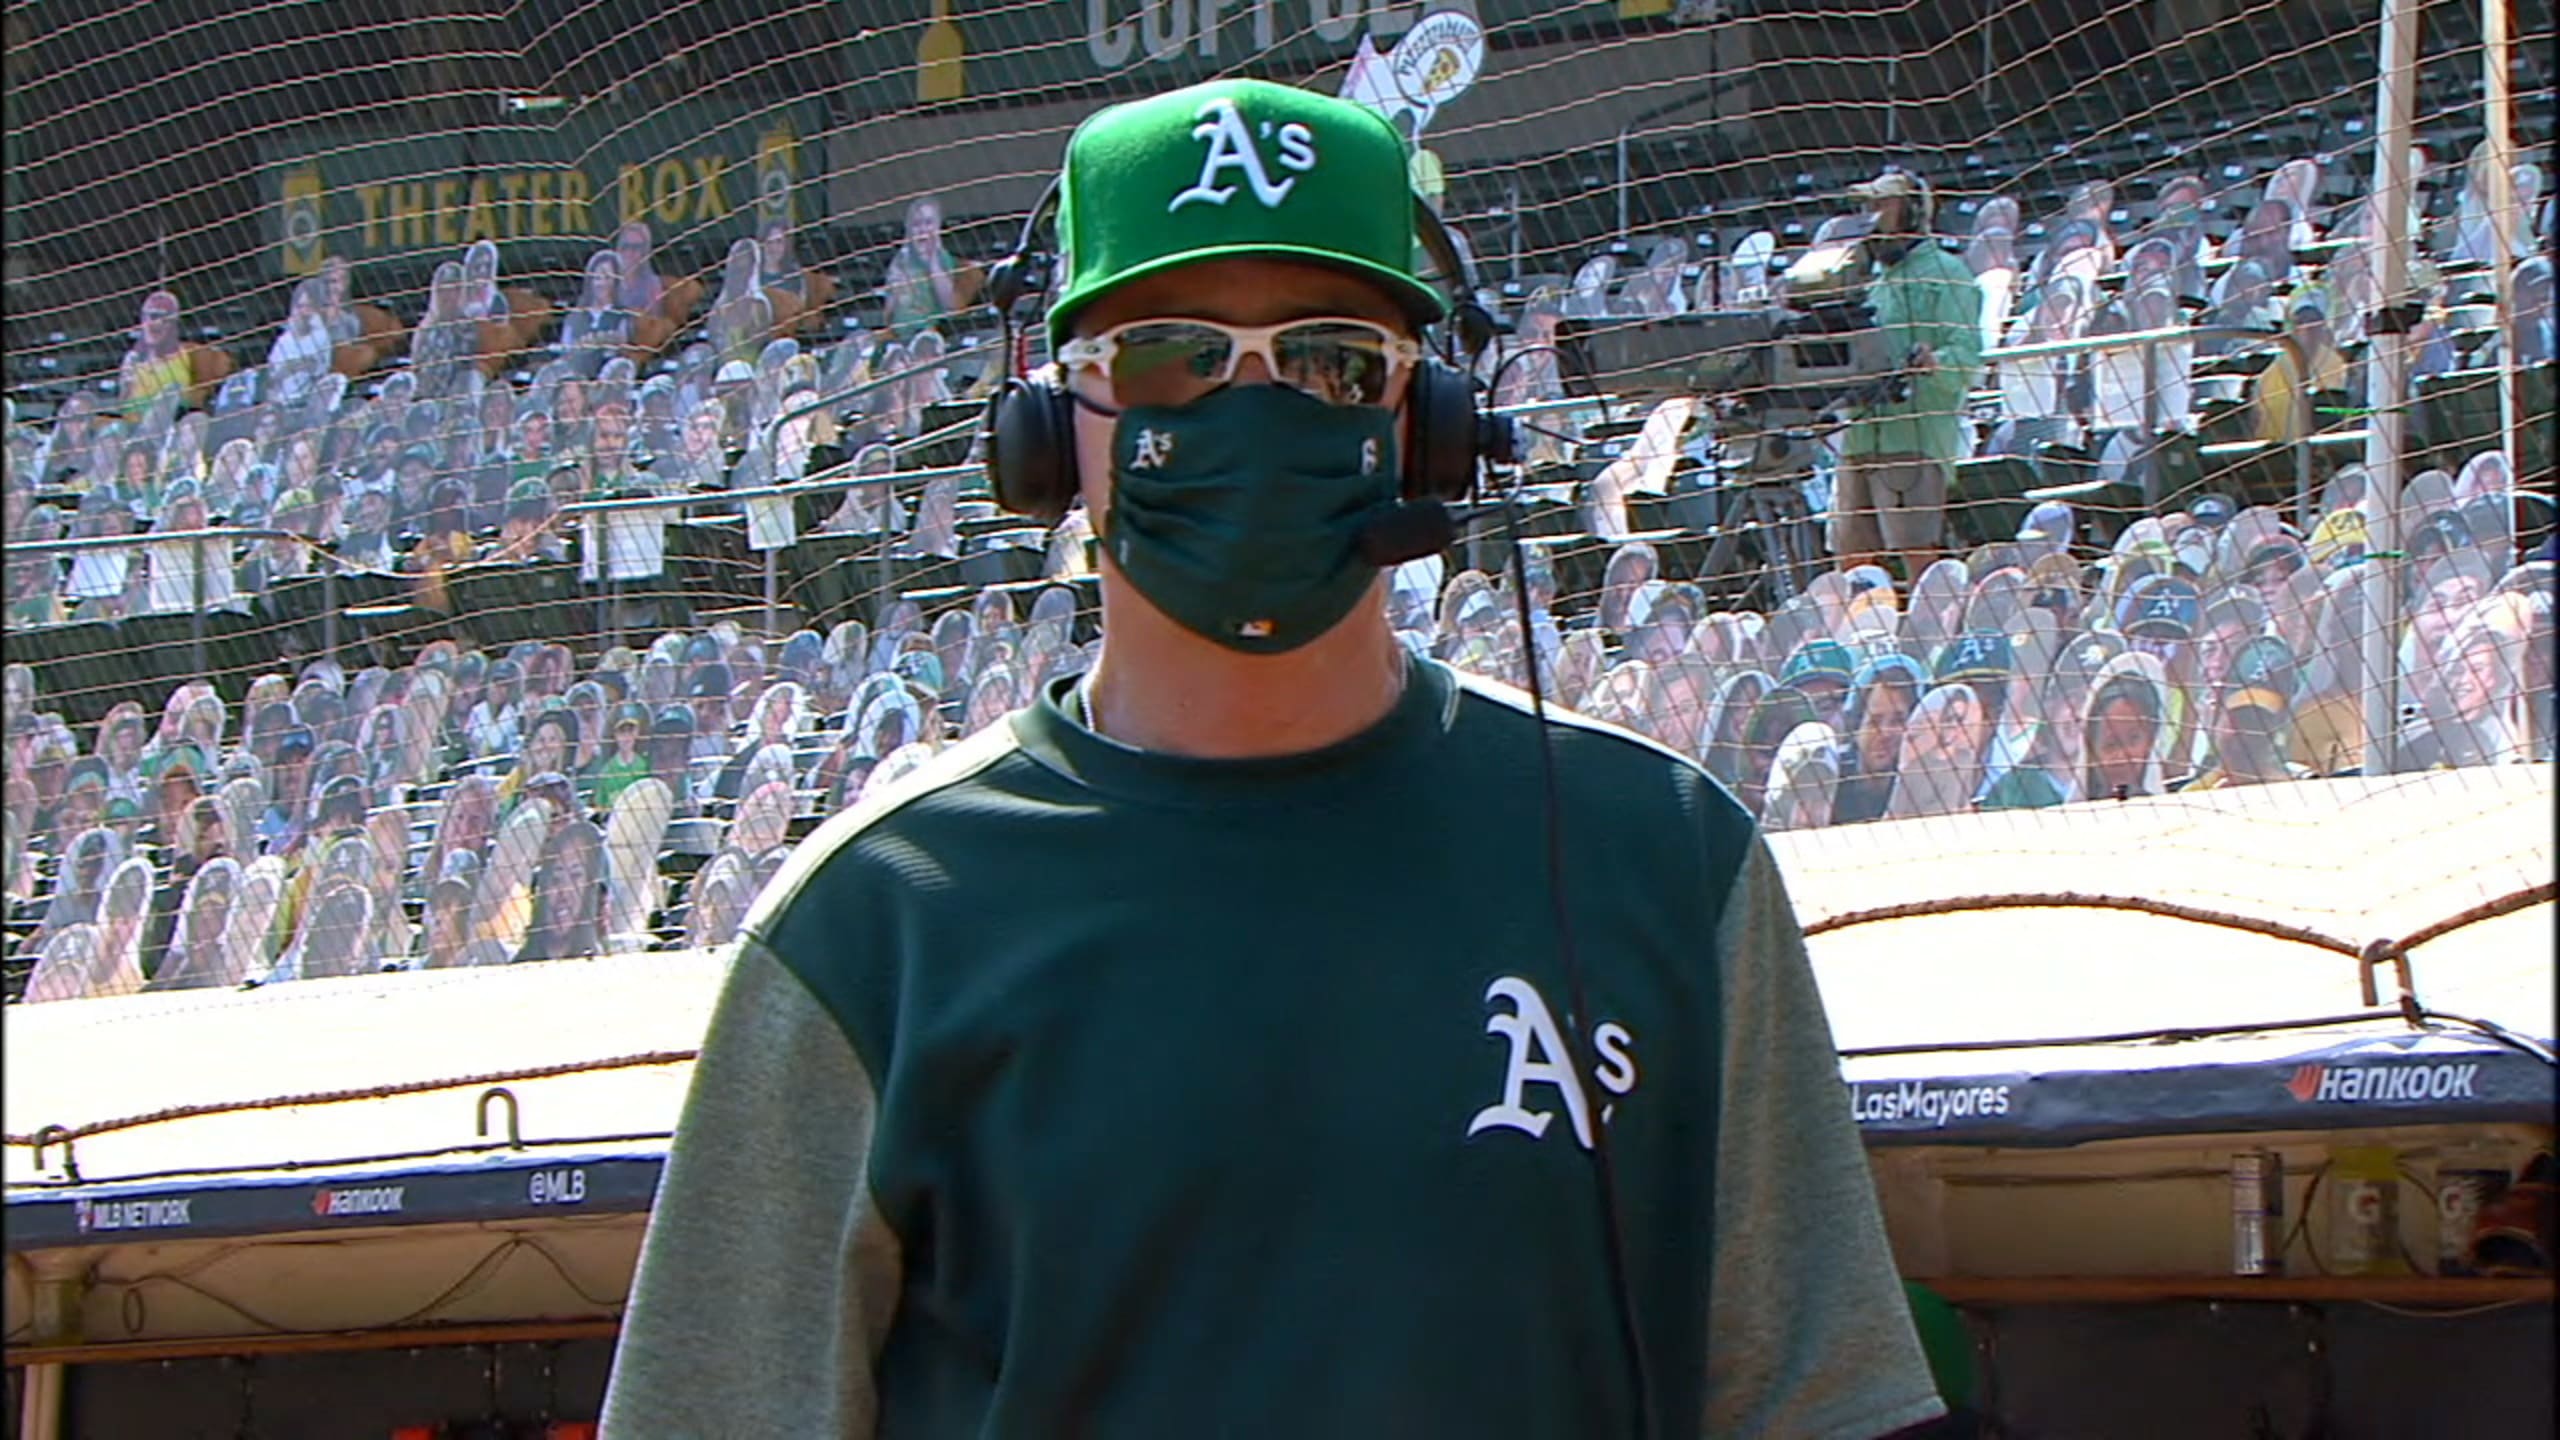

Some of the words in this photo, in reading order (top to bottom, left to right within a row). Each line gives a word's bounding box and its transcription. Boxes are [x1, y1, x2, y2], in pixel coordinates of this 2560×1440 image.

[1087, 0, 1482, 68] COPPO
[1168, 98, 1316, 212] A's
[355, 169, 592, 248] THEATER
[617, 156, 731, 226] BOX
[1851, 1081, 2010, 1127] LasMayores
[123, 1199, 192, 1229] NETWORK
[529, 1169, 586, 1203] @MLB
